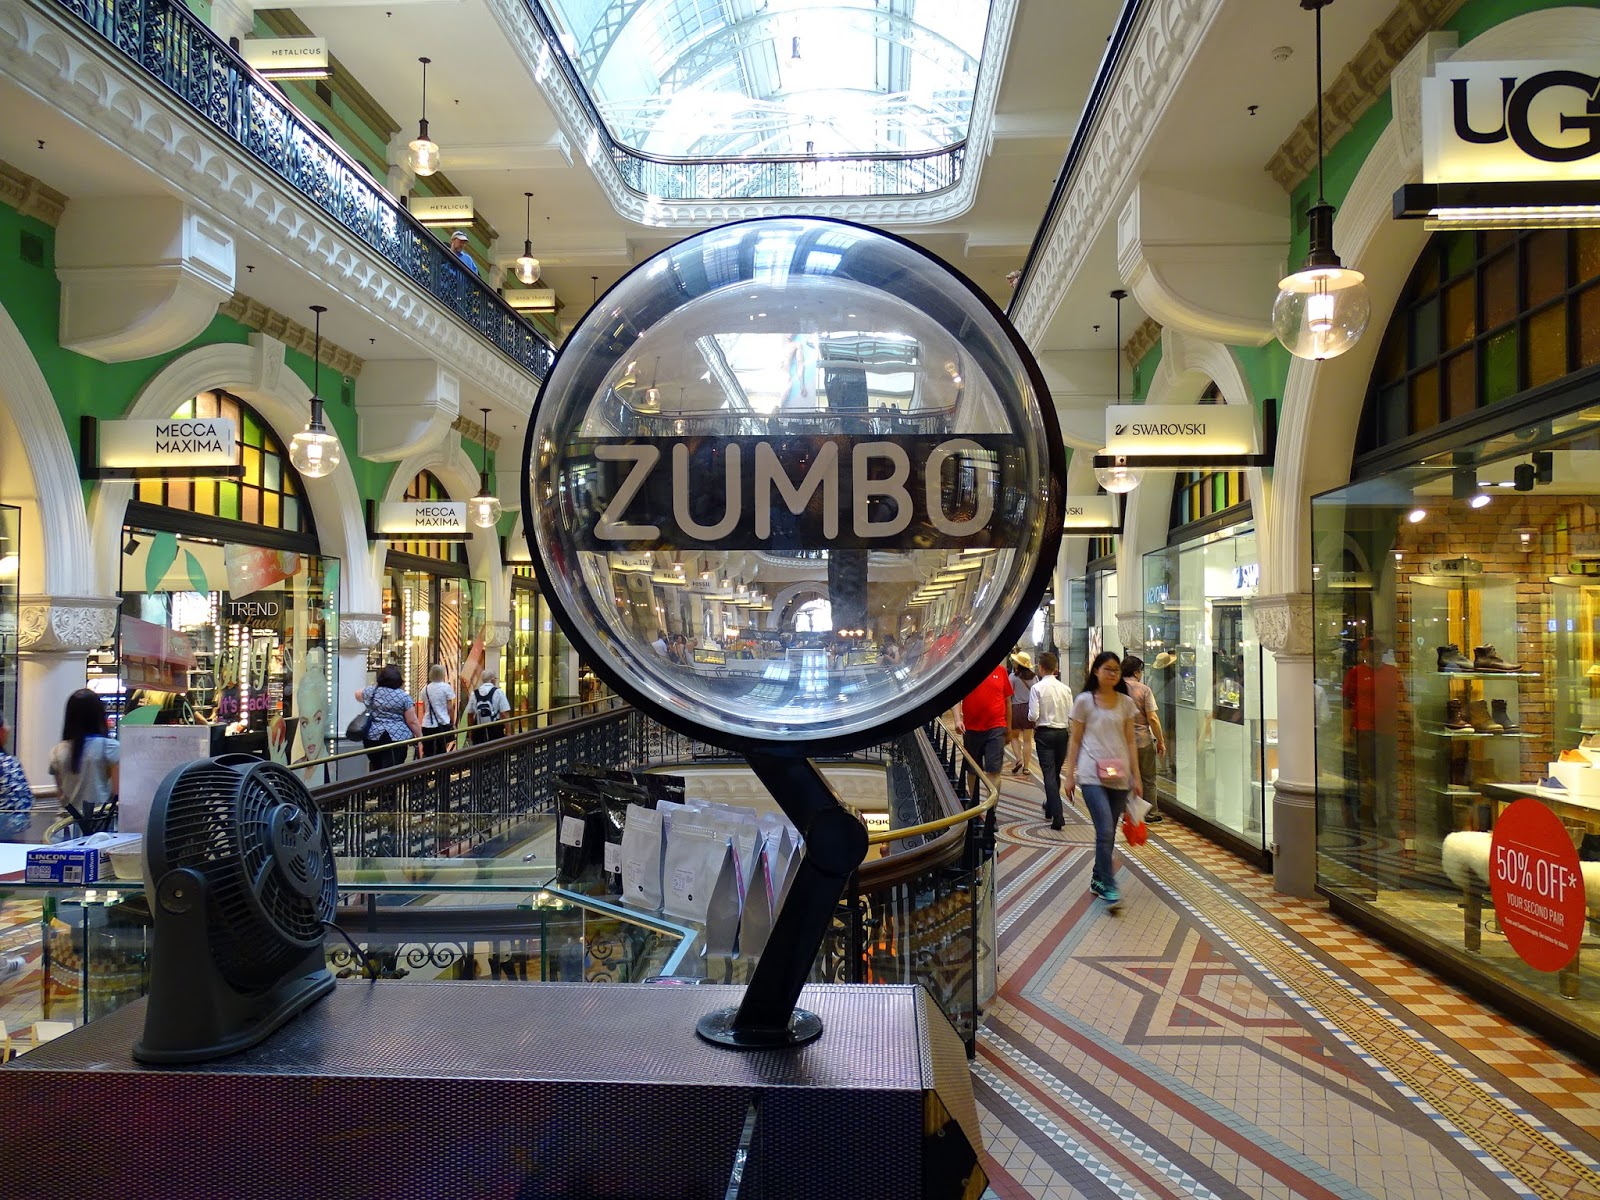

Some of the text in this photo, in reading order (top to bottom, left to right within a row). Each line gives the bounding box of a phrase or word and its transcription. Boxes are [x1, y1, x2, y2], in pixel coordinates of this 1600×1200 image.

[271, 48, 321, 56] METALICUS
[156, 423, 217, 437] MECCA
[1132, 423, 1206, 435] SWAROVSKI
[156, 440, 223, 453] MAXIMA
[594, 438, 996, 541] ZUMBO
[416, 507, 456, 517] MECCA
[415, 517, 459, 526] MAXIMA
[228, 602, 279, 616] TREND
[1497, 845, 1533, 890] 50%
[1507, 892, 1564, 927] YOUR SECOND PAIR
